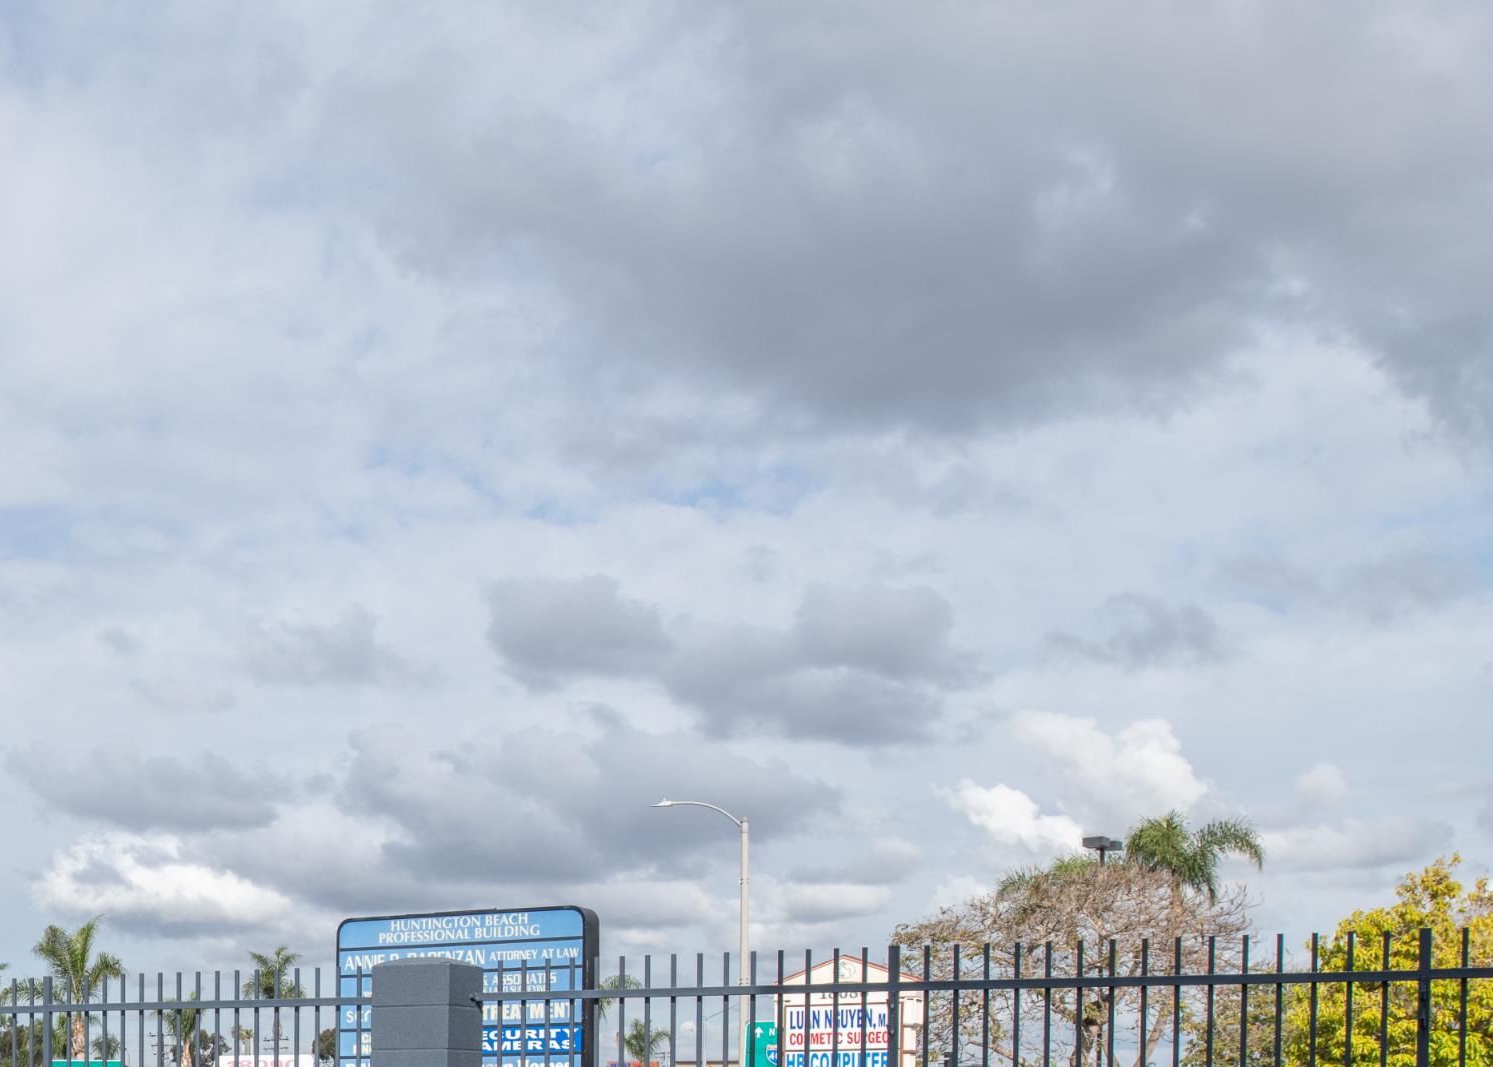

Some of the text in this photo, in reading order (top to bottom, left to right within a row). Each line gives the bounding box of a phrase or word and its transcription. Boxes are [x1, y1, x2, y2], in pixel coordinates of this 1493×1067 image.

[391, 913, 528, 932] HUNTINGTON BEACH
[379, 924, 540, 944] PROFESSIONAL BUILDING
[489, 947, 579, 961] ATTORNEY AT LAW
[492, 972, 557, 985] ASSOIATS
[790, 1010, 820, 1029] LUN
[825, 1008, 876, 1030] NUYEN,
[482, 1028, 579, 1041] ECURITY
[790, 1030, 888, 1045] COMETC SUGEO
[482, 1039, 577, 1051] AMERAS
